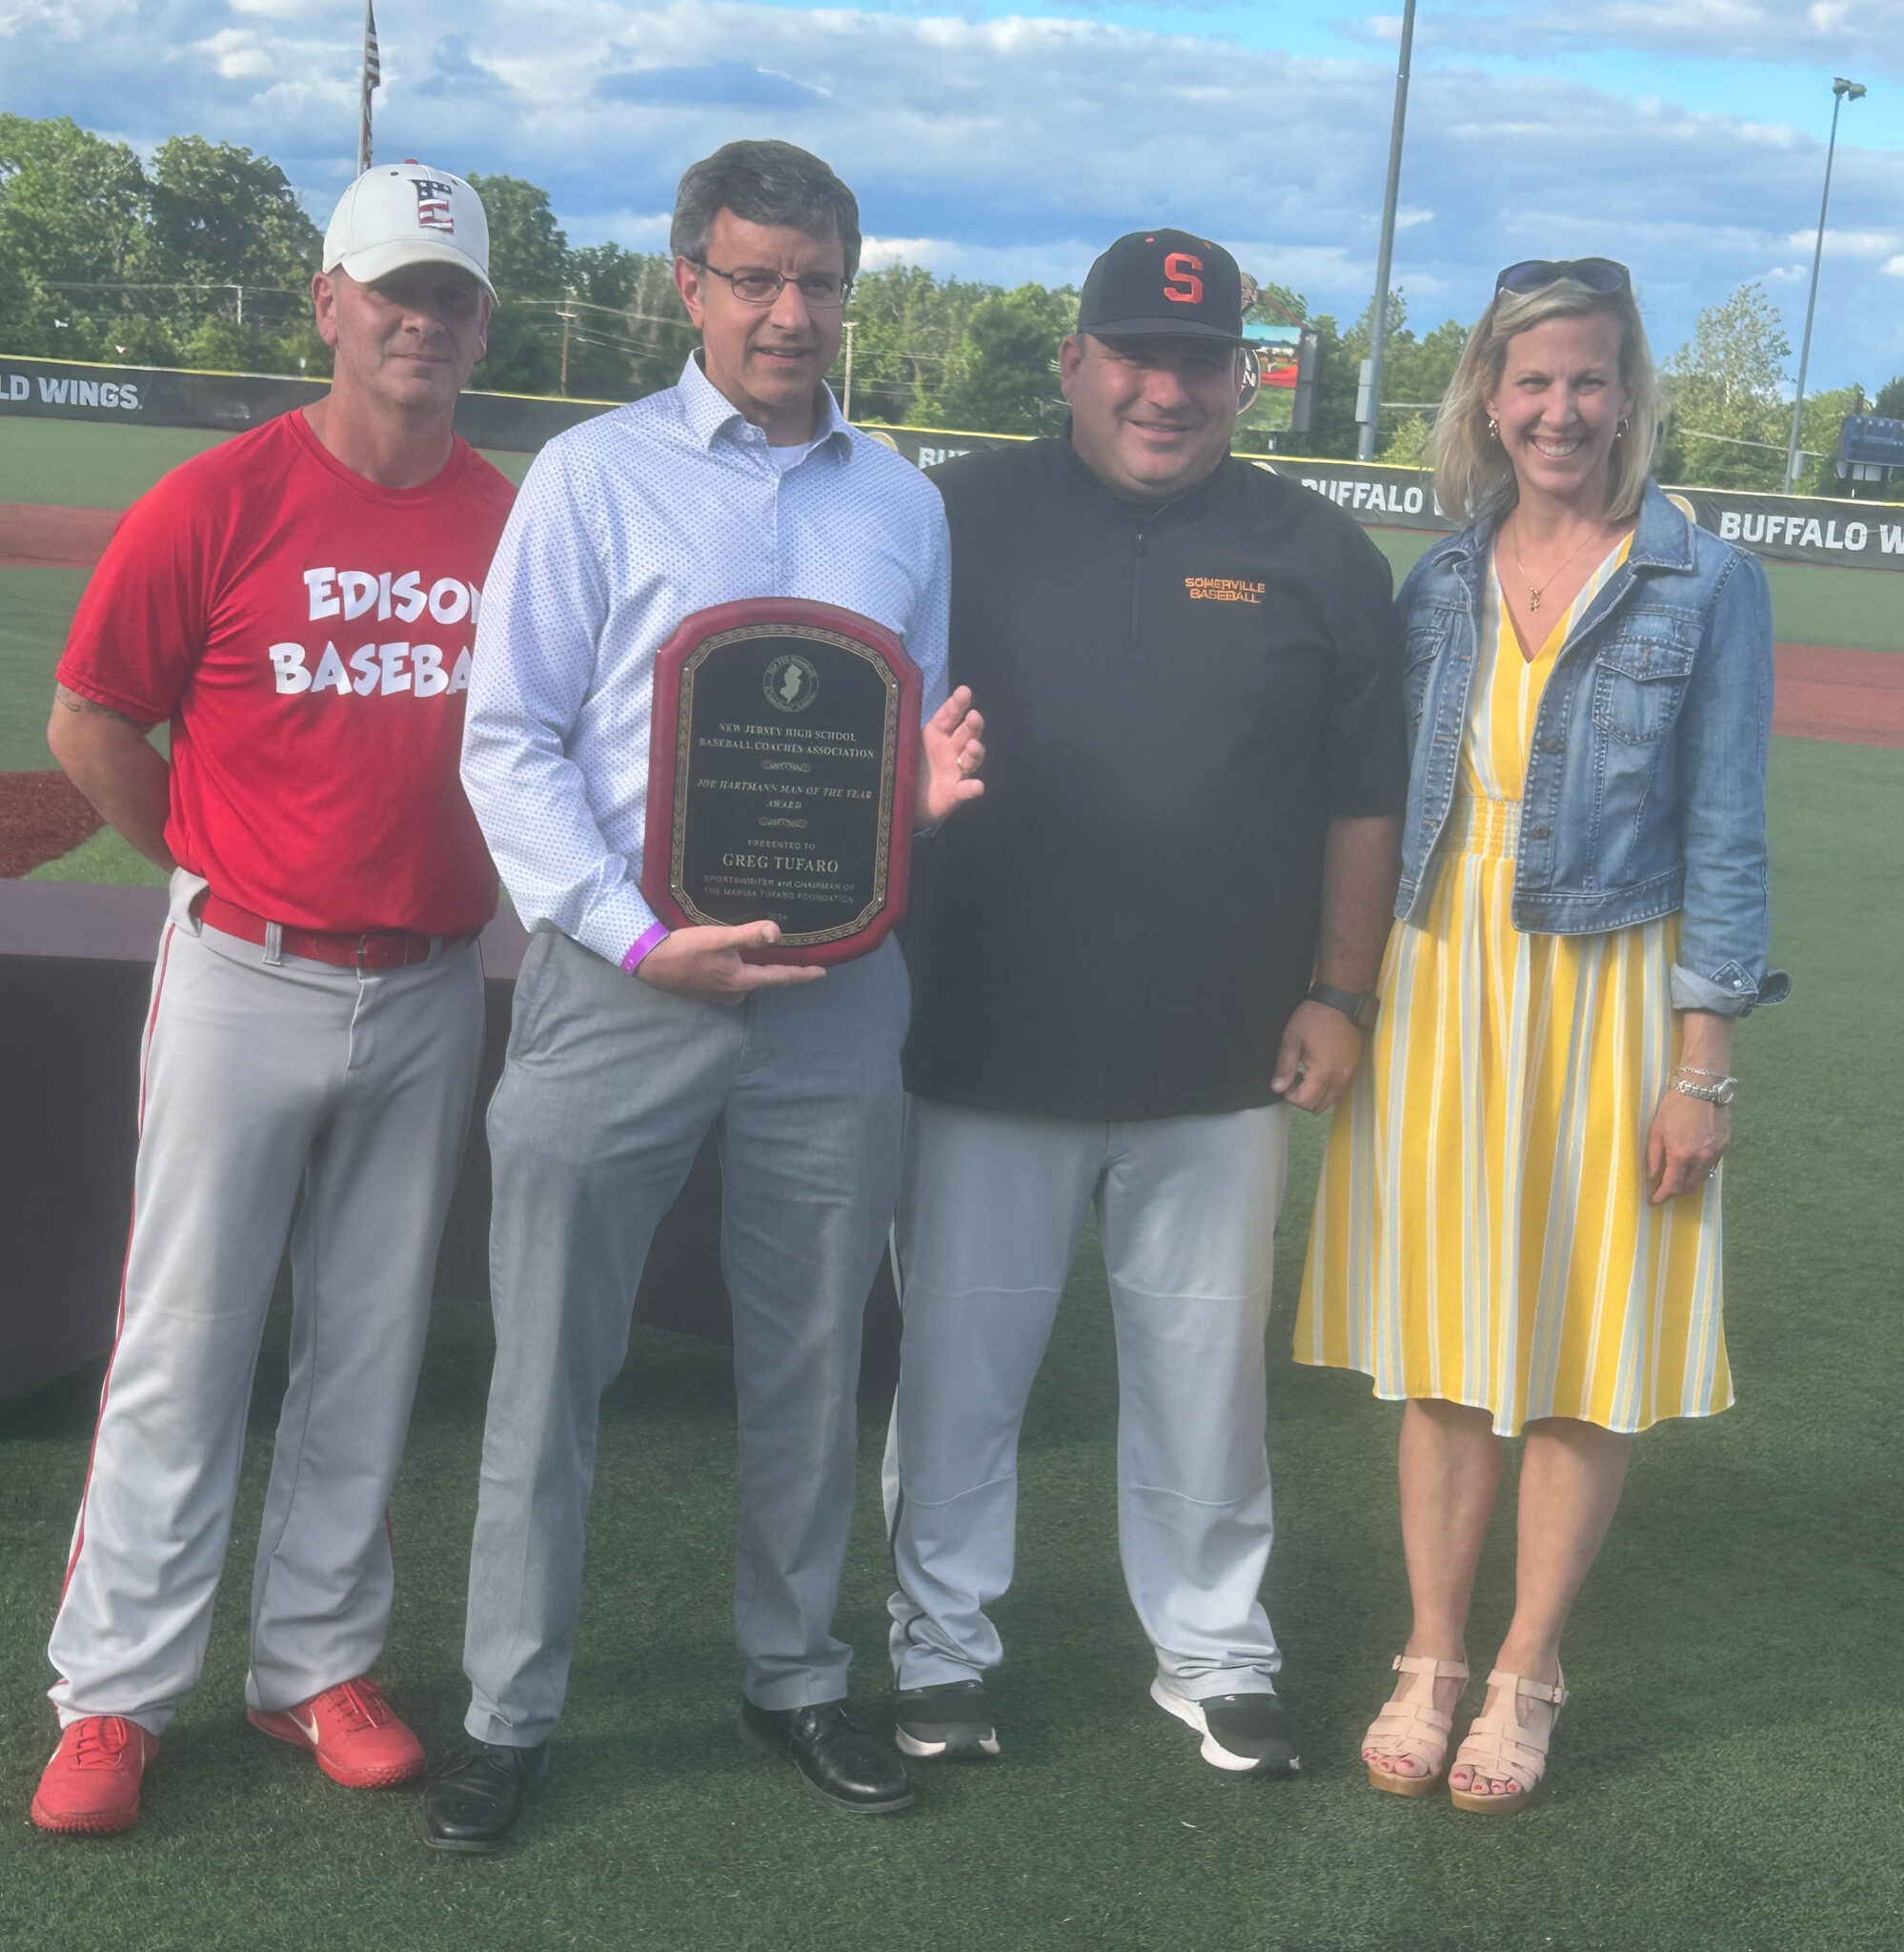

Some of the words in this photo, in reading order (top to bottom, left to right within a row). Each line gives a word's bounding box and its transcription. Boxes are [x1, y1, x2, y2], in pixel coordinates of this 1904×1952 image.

[408, 179, 454, 235] E
[1164, 253, 1204, 304] S
[1719, 512, 1868, 551] BUFFALO
[1185, 578, 1266, 593] SOMERVILLE
[1189, 588, 1261, 603] BASEBALL
[718, 722, 740, 733] NEW
[744, 724, 781, 736] JERSEY
[785, 727, 812, 738] HIGH
[815, 730, 857, 742] SCHOOL
[699, 737, 753, 750] BASEBALL
[755, 742, 803, 753] COACHES
[807, 746, 874, 759] ASSOCIATION
[696, 778, 717, 788] JOE
[780, 784, 803, 794] MAN
[805, 786, 820, 796] OF
[822, 787, 843, 797] THE
[846, 788, 873, 799] YEAR
[766, 800, 801, 809] AWARD
[747, 839, 801, 850] PRESENTED
[803, 842, 816, 851] TO
[722, 853, 768, 868] GREG
[774, 856, 839, 873] TUFARO
[703, 875, 774, 886] SPORTSWRITER
[794, 881, 841, 891] CHAIRMAN
